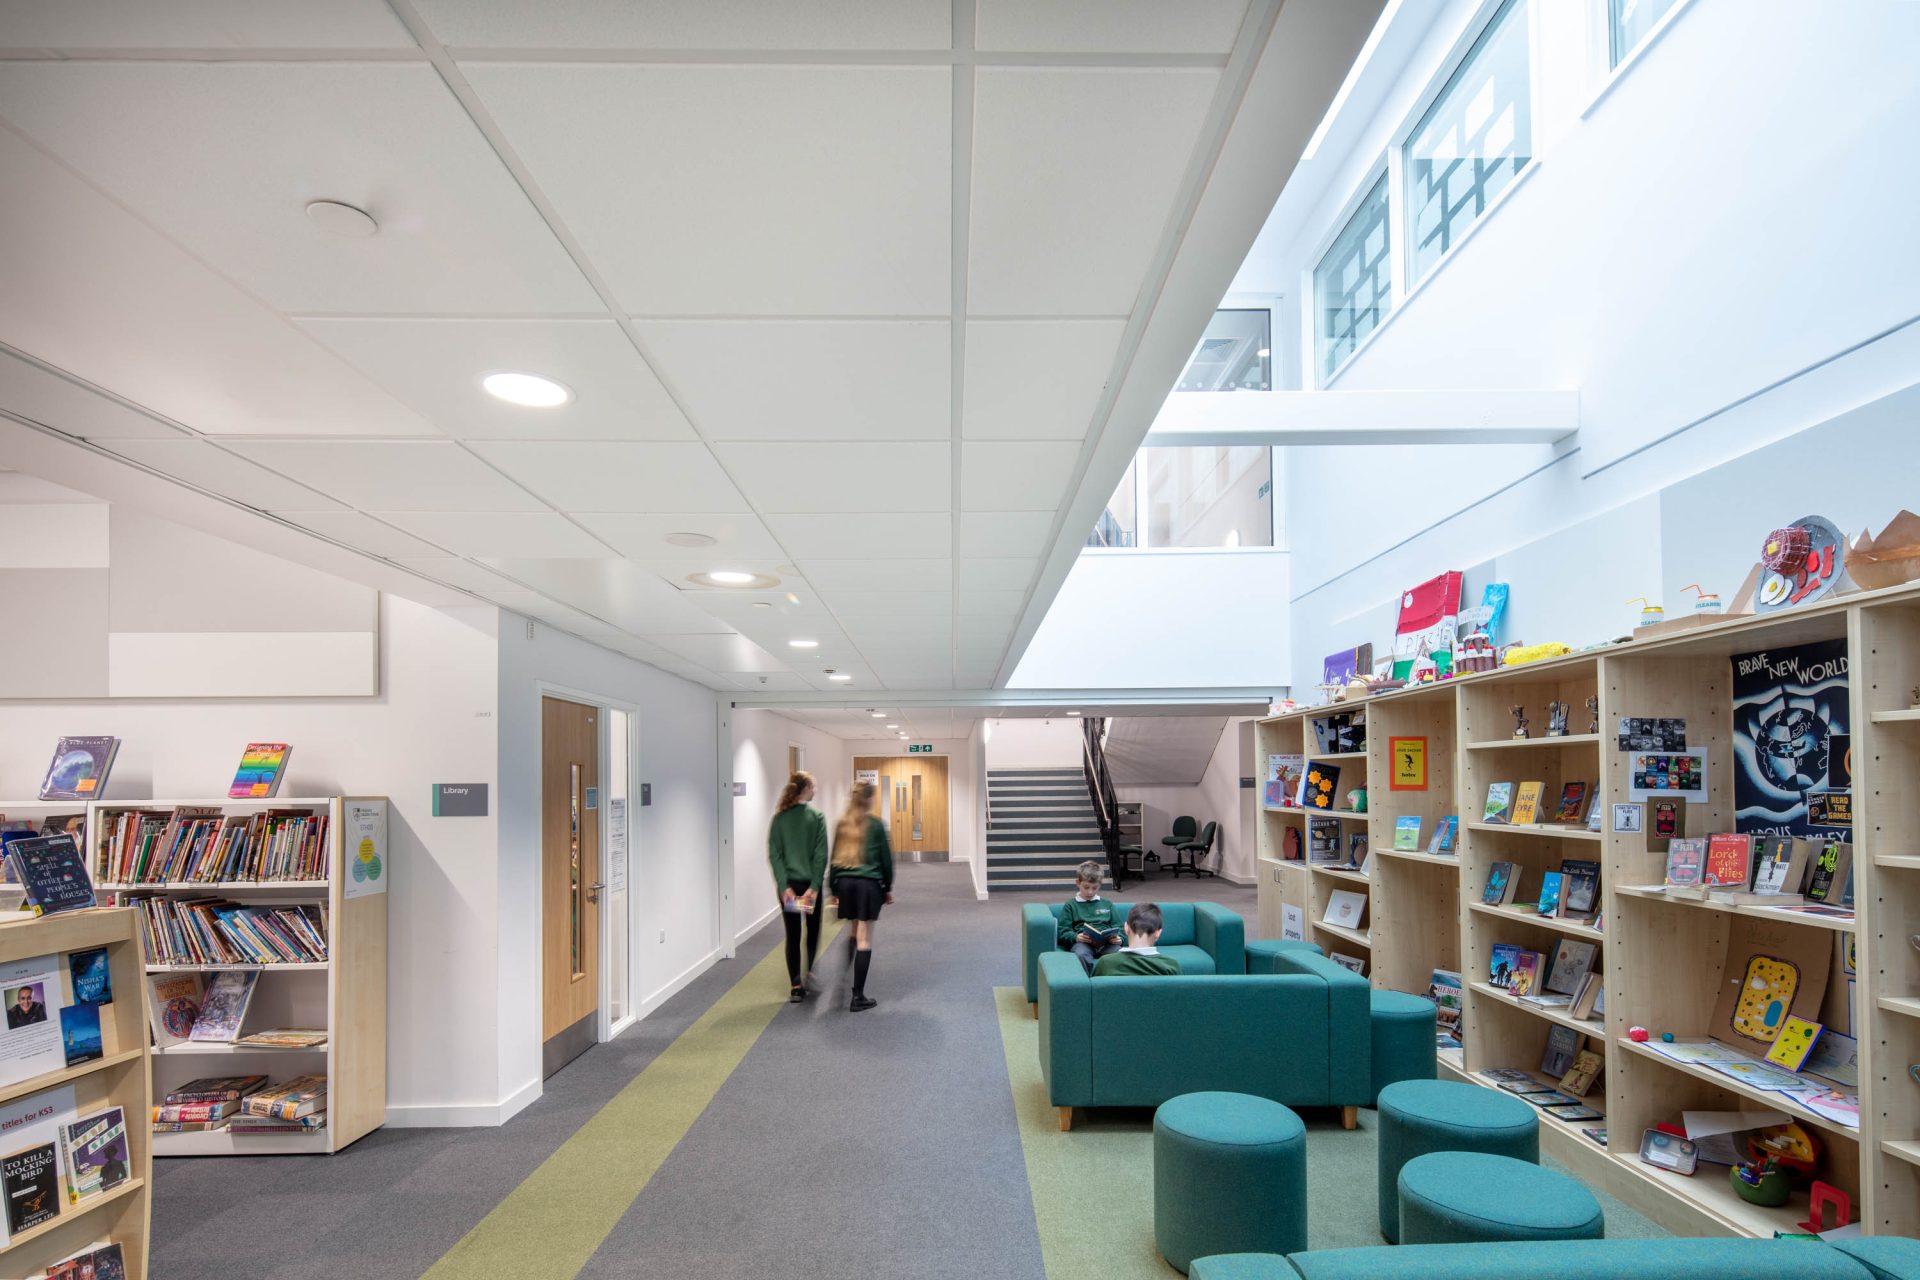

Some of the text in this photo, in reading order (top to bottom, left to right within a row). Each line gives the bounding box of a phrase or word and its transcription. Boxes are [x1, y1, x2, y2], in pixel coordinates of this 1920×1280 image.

[1738, 653, 1849, 685] BRAVE NEW WORLD
[443, 786, 469, 795] Library
[1519, 793, 1537, 802] JANE
[1833, 804, 1847, 812] THE
[1828, 811, 1852, 820] GAMES
[1710, 848, 1737, 859] Lord
[1718, 867, 1744, 879] Flies
[78, 975, 105, 986] NISHA'S
[84, 983, 100, 991] WAR
[2, 1106, 54, 1131] titles for KS3
[4, 1160, 20, 1171] TO
[23, 1153, 46, 1166] KILL
[5, 1157, 55, 1179] MOCKING-
[21, 1168, 43, 1181] BIRD
[17, 1217, 43, 1232] HARPER
[43, 1212, 55, 1221] LEE
